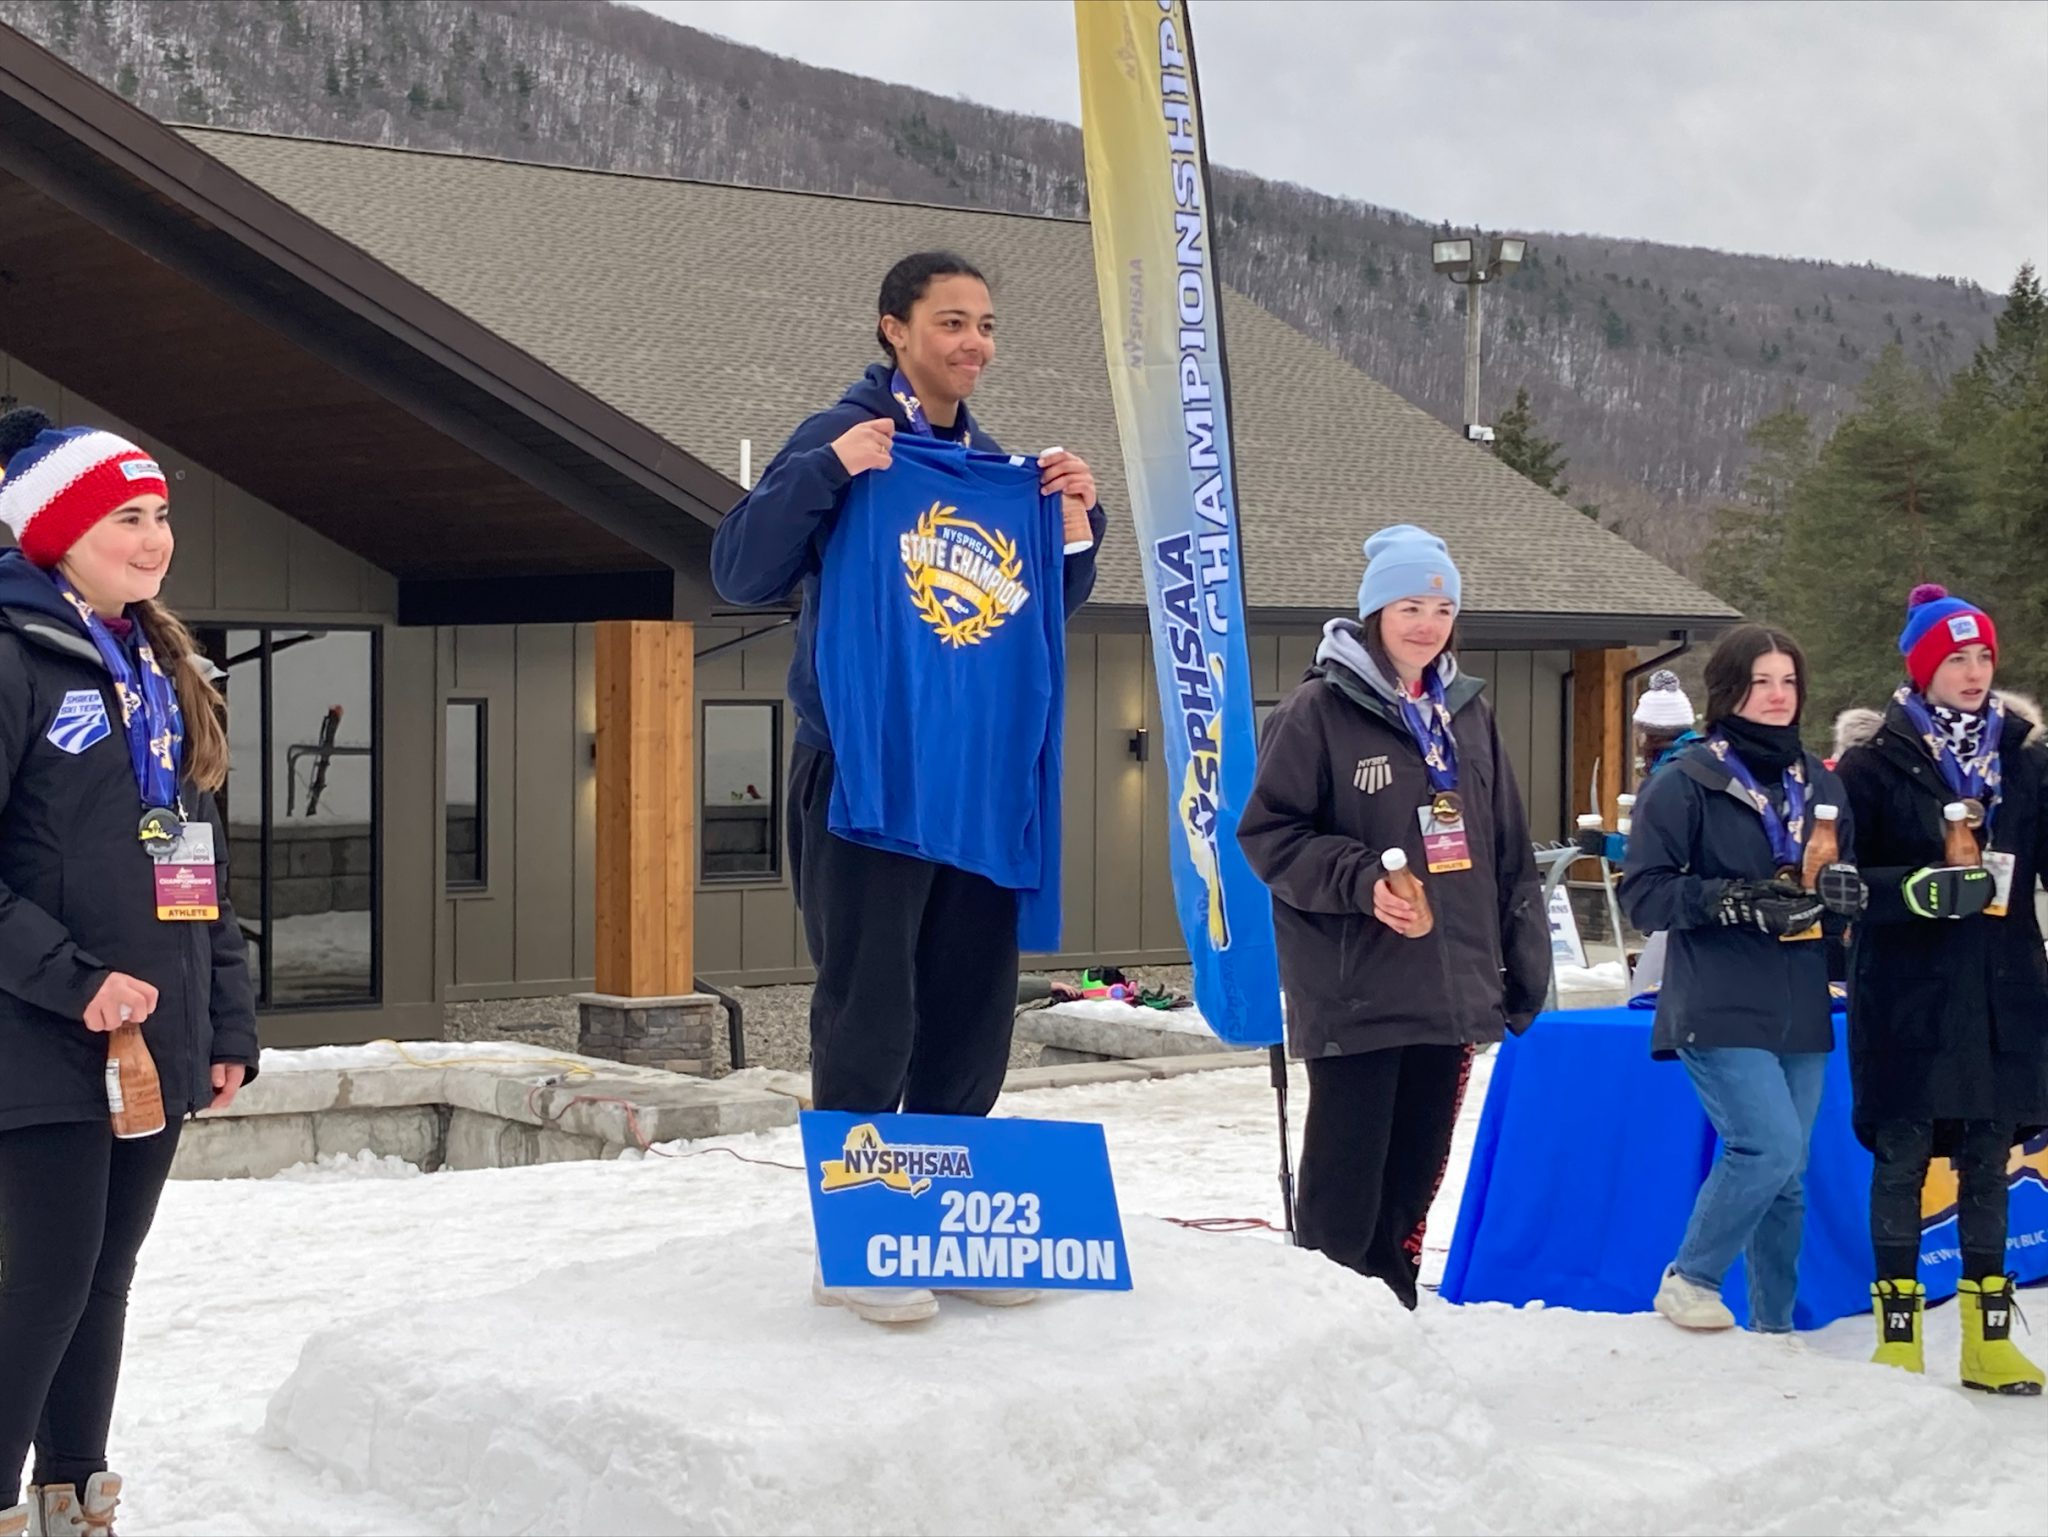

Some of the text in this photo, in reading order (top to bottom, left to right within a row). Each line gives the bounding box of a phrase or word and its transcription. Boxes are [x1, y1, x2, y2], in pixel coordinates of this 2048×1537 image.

[1157, 0, 1229, 636] CHAMPIONSHIP
[943, 527, 994, 560] NYSPHSAA
[900, 533, 1031, 615] STATE CHAMPION
[168, 908, 208, 918] ATHLETE
[844, 1149, 973, 1178] NYSPHSAA
[939, 1190, 1041, 1235] 2023
[2006, 1229, 2047, 1251] PUBLIC
[866, 1233, 1117, 1281] CHAMPION
[1920, 1248, 1952, 1267] NEW
